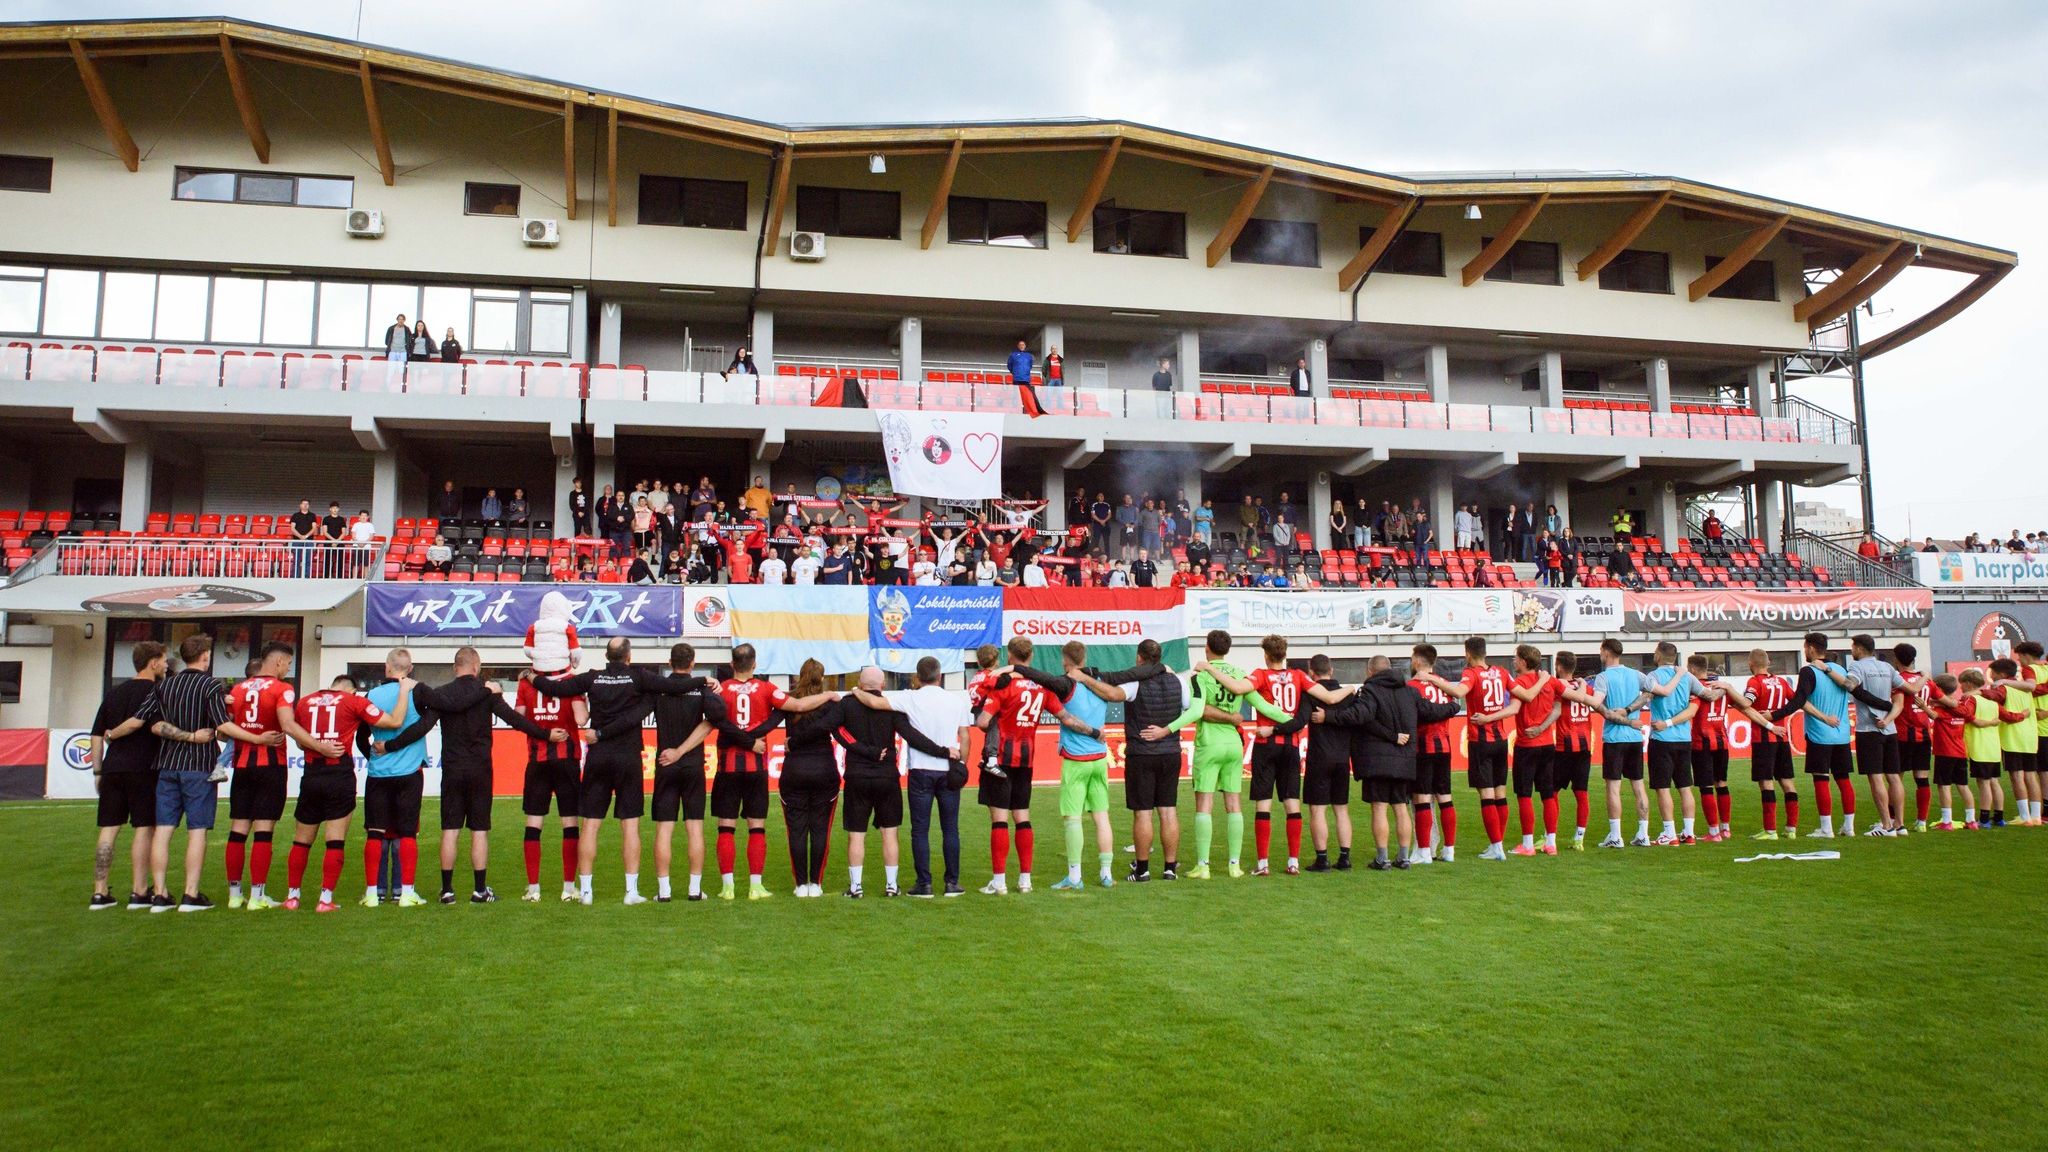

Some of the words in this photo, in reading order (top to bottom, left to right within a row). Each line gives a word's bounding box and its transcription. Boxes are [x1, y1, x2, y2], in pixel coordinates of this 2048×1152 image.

[907, 318, 918, 332] F
[1314, 339, 1324, 352] G
[1657, 358, 1667, 371] G
[1973, 556, 2048, 586] harpla
[915, 594, 1001, 612] Lokálpatrióták
[1240, 600, 1336, 621] TENROM
[1635, 602, 1733, 622] VOLTUNK.
[1738, 602, 1834, 622] VAGYUNK.
[1838, 597, 1926, 620] LESZÜNK.
[928, 617, 988, 634] Csíkszereda
[1272, 683, 1297, 713] 90
[1482, 678, 1505, 707] 20
[1766, 685, 1784, 710] 77
[245, 690, 260, 723] 3
[736, 693, 751, 725] 9
[1016, 690, 1044, 723] 24
[308, 706, 340, 739] 11
